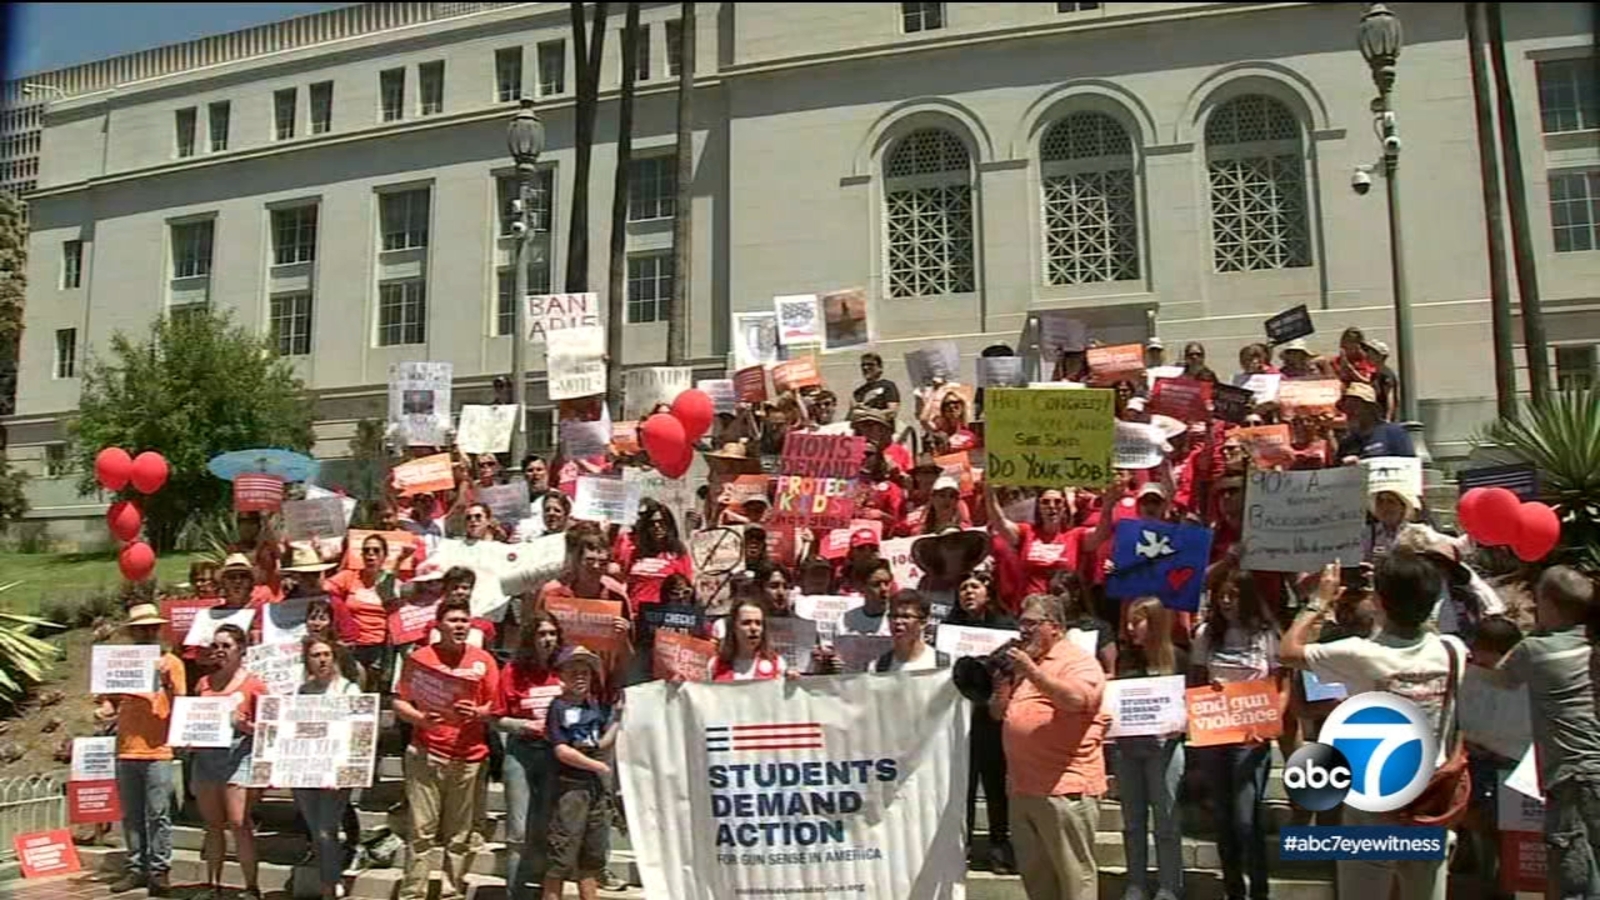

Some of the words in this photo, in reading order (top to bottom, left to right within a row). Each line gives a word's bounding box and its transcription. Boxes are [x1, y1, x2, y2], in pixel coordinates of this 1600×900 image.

[529, 294, 586, 317] BAN
[786, 437, 853, 459] MOMS
[988, 451, 1016, 479] DO
[1021, 452, 1064, 481] YOUR
[1190, 694, 1228, 715] end
[1230, 693, 1270, 714] gun
[1194, 708, 1279, 730] violence
[709, 758, 898, 789] STUDENTS
[712, 791, 862, 818] DEMAND
[716, 819, 845, 848] ACTION
[717, 853, 738, 866] FOR
[740, 853, 766, 866] GUN
[768, 852, 806, 866] SENSE
[808, 852, 822, 864] IN
[825, 848, 882, 862] AMERICA
